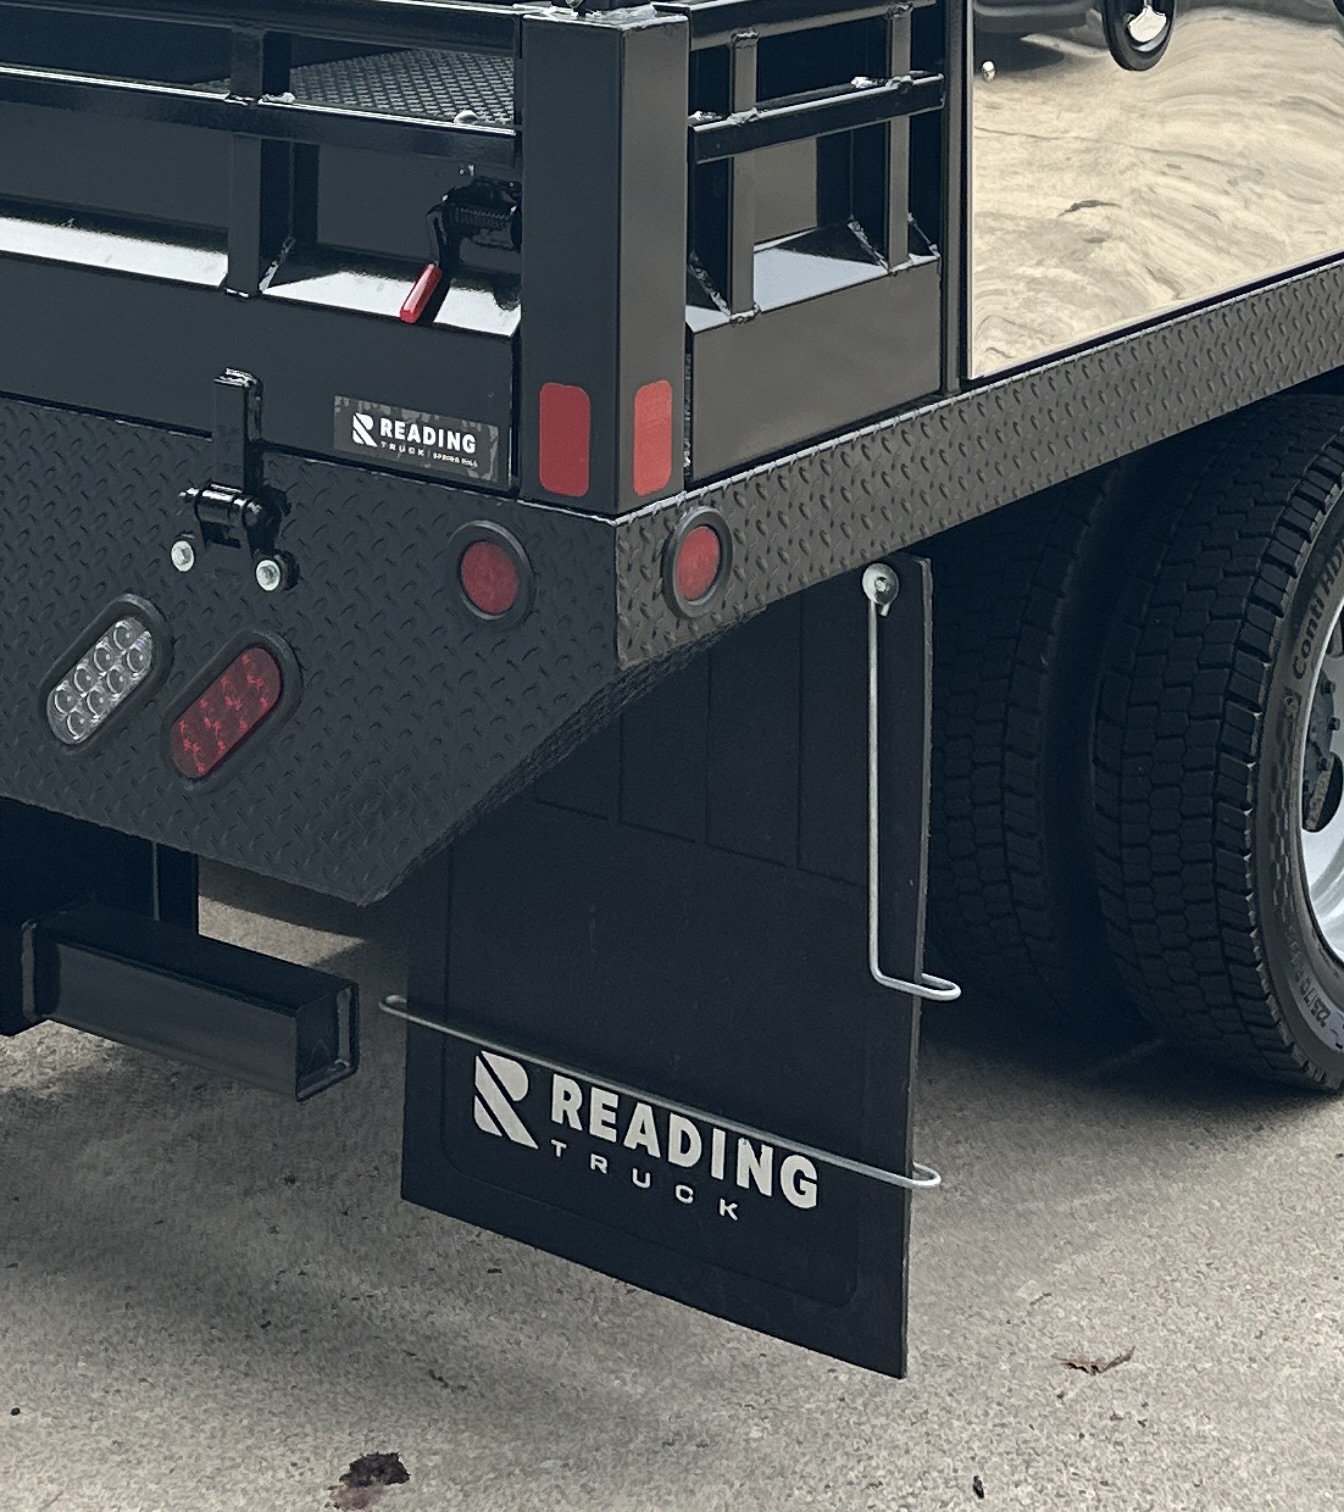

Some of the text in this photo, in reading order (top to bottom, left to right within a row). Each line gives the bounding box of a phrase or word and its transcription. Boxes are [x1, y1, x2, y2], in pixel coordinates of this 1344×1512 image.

[380, 417, 476, 454] READING
[381, 441, 424, 456] TRUCK
[1293, 592, 1326, 679] Conti
[551, 1073, 818, 1209] READING
[551, 1139, 738, 1221] TRUCK
